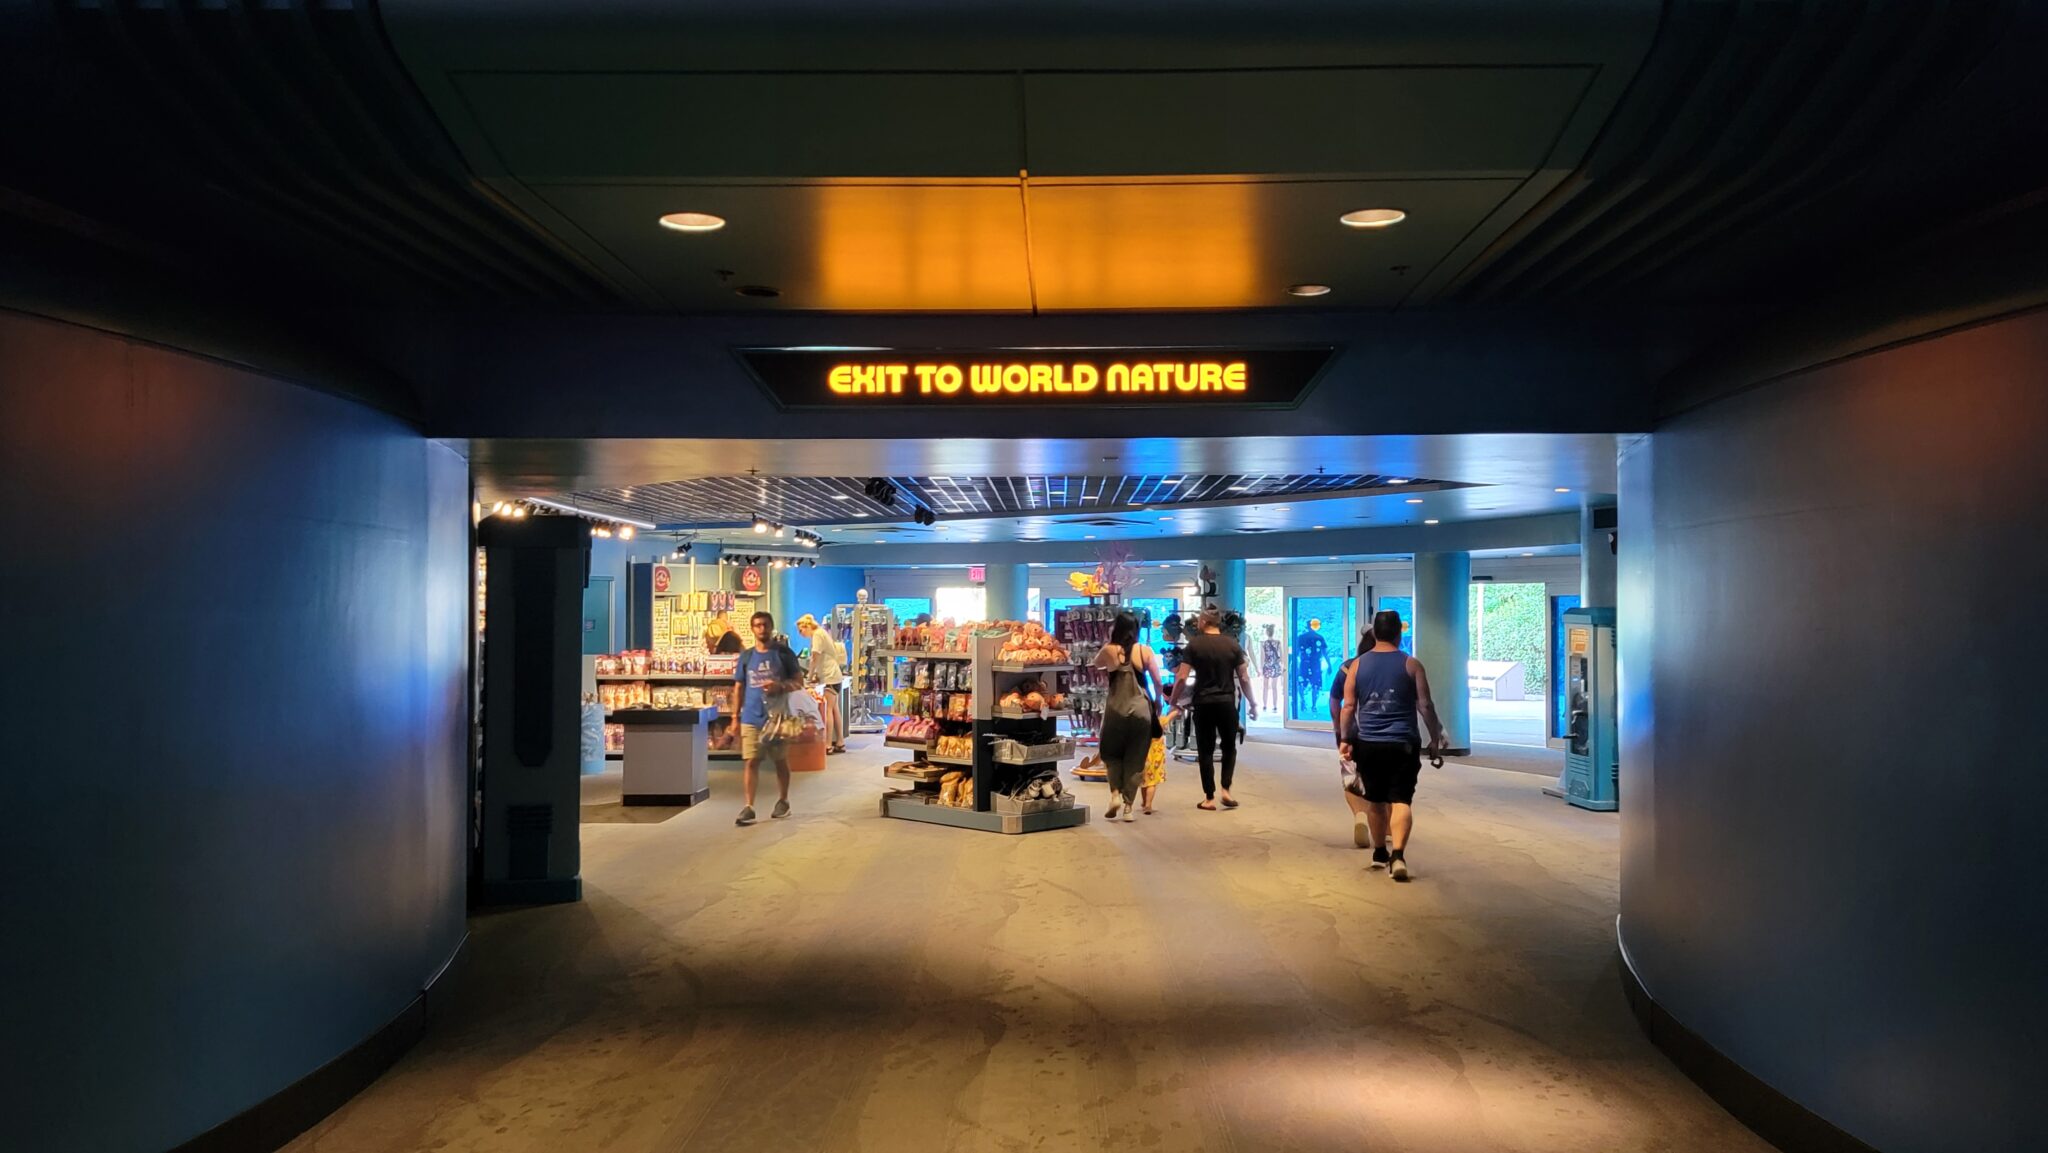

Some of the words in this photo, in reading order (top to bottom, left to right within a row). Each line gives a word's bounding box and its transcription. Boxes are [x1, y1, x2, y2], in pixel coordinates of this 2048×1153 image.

[829, 364, 908, 393] EXIT
[915, 364, 963, 393] TO
[970, 364, 1098, 393] WORLD
[1106, 363, 1246, 391] NATURE
